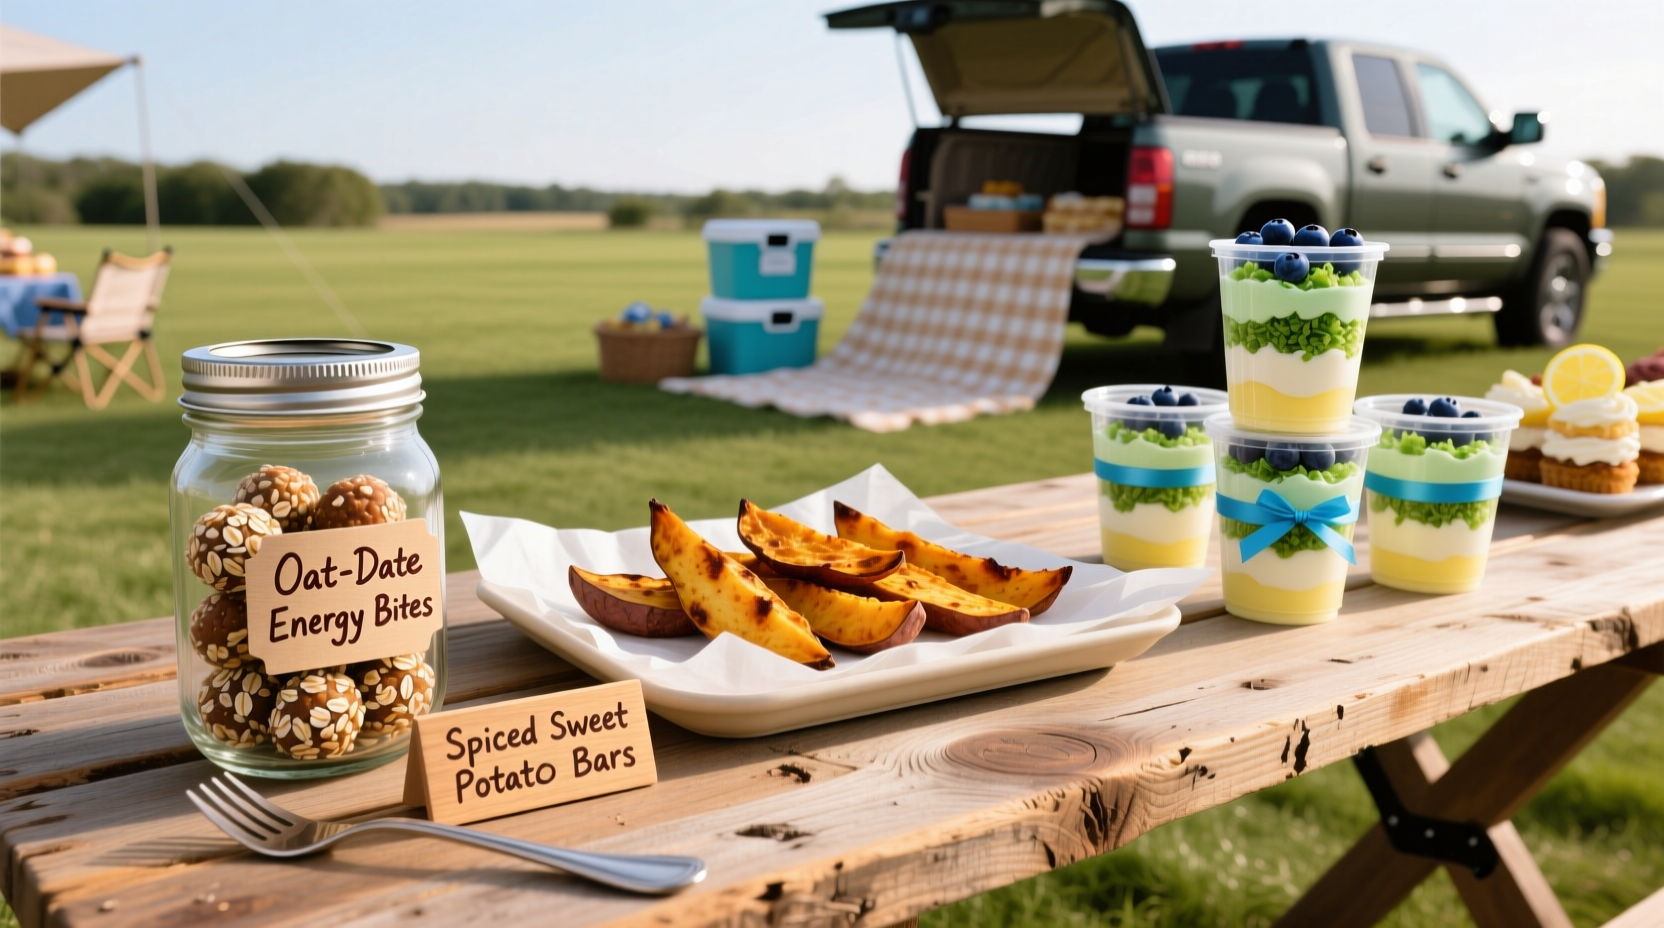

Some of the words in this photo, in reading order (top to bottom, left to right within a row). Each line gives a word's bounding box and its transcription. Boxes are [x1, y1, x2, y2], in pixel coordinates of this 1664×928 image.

[274, 546, 423, 597] Oat-Date
[269, 605, 365, 647] Energy
[374, 593, 433, 627] Bites
[445, 714, 538, 768] Spiced
[550, 701, 629, 741] Sweet
[455, 759, 557, 804] Potato
[572, 746, 636, 778] Bars
